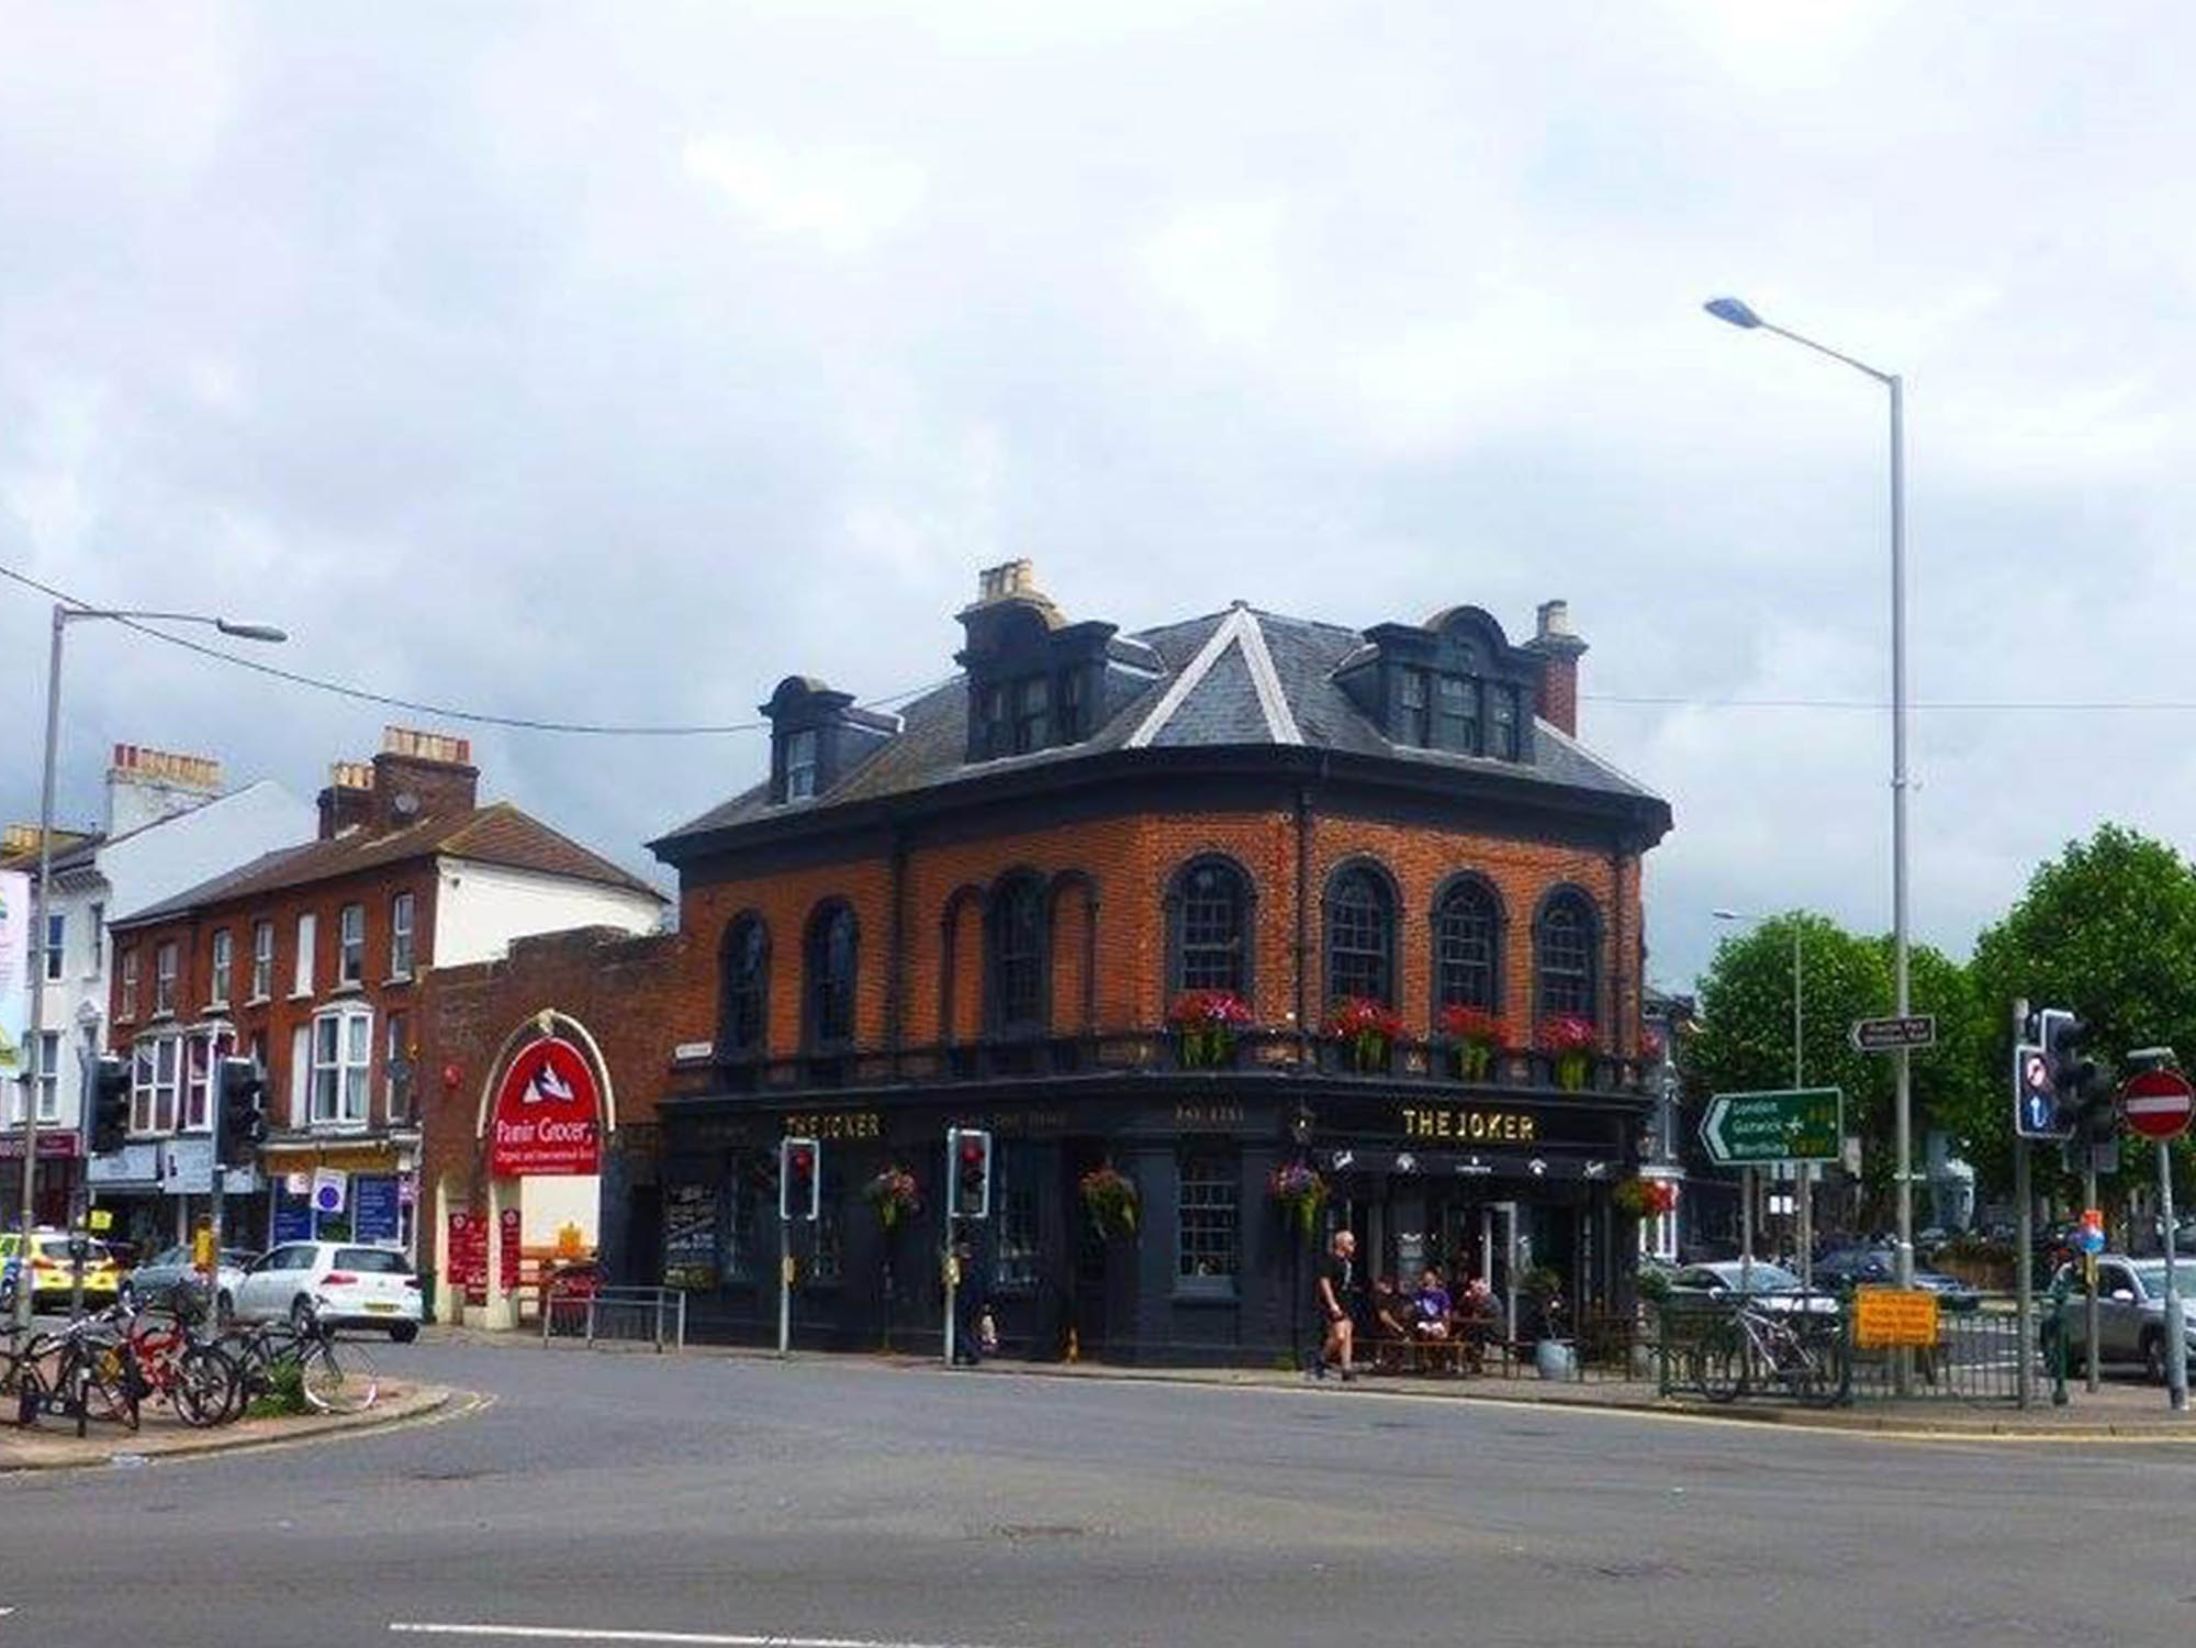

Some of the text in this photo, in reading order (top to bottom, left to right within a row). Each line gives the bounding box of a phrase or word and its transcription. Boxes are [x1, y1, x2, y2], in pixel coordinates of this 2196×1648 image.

[1732, 1102, 1778, 1115] London
[786, 1113, 880, 1138] THE JOKER
[1402, 1109, 1534, 1140] THE JOKER
[1732, 1120, 1782, 1134] Gatwick
